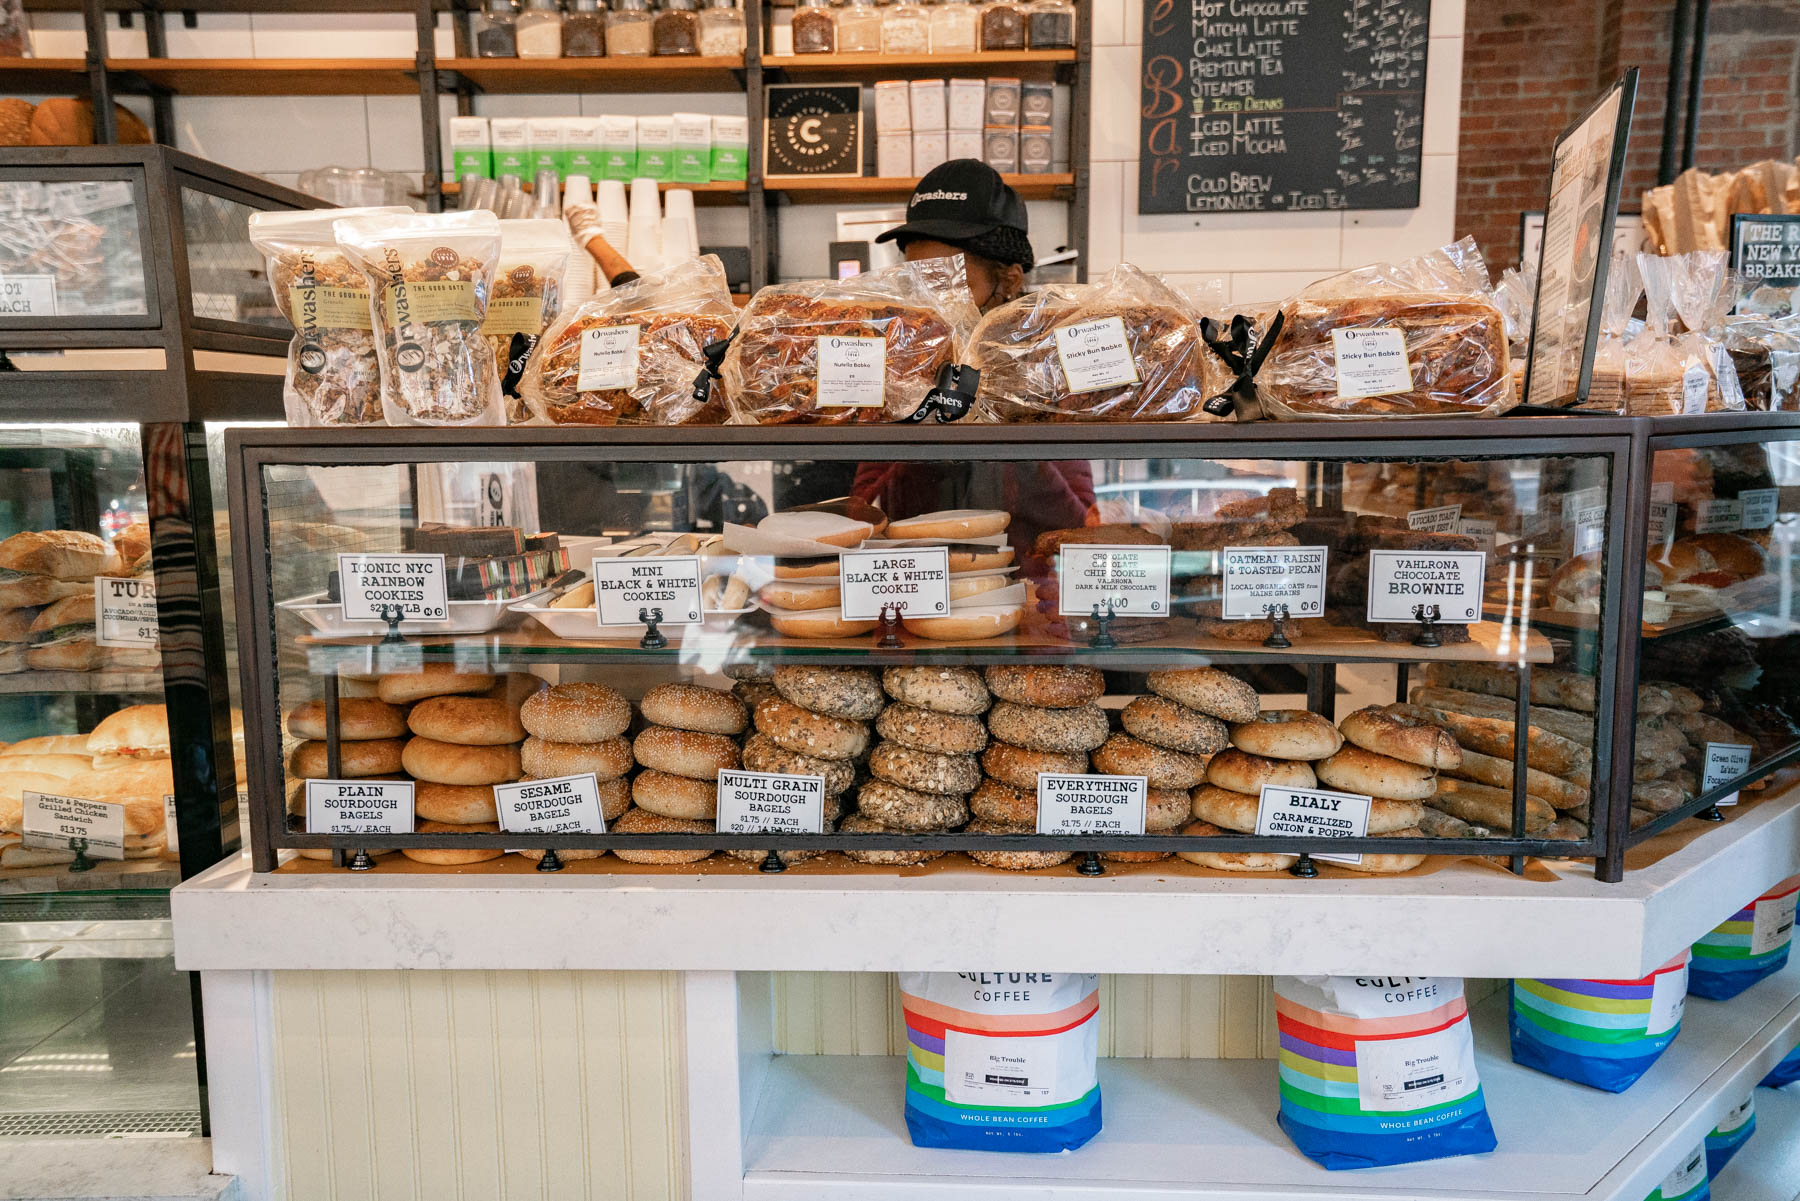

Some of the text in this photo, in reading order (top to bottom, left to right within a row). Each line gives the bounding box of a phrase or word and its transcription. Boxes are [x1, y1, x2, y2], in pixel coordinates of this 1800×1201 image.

[1192, 0, 1309, 17] HOT CHOCOLATE
[1192, 17, 1248, 38] MATCHA
[1254, 16, 1299, 36] LATTE
[1194, 37, 1283, 58] CHAI LATTE
[1189, 55, 1284, 78] PREMIUM TEA
[1190, 78, 1256, 97] STEAMER
[1211, 97, 1285, 112] ICED DRINKS
[1190, 112, 1284, 136] ICED LATTE
[1189, 134, 1287, 156] ICED MOCHA
[1187, 171, 1273, 194] COLD BREW
[1186, 192, 1265, 212] LEMONADE
[1287, 191, 1324, 210] ICED
[1323, 188, 1350, 209] TEA
[1750, 225, 1782, 241] THE
[1747, 245, 1800, 260] NEW Y
[323, 290, 356, 299] THE GOOD
[0, 300, 31, 312] ACH
[592, 329, 629, 339] Orwashers
[1068, 323, 1110, 339] Orwashers
[1345, 331, 1389, 340] Orwashers
[831, 338, 873, 348] Orwashers
[1066, 350, 1086, 360] Sticky
[1101, 343, 1123, 352] Babka
[873, 559, 916, 570] LARGE
[1229, 554, 1321, 564] OATMEAL RAISIN
[1396, 560, 1460, 570] VAHLRONA
[351, 563, 433, 574] ICONIC NYC
[632, 567, 664, 577] MINI
[1110, 570, 1146, 578] COOKIE
[1228, 565, 1321, 575] & TOASTED PECAN
[361, 576, 425, 587] RAINBOW
[846, 570, 944, 583] BLACK & WHITE
[1394, 571, 1460, 580] CHOCOLATE
[601, 578, 697, 590] BLACK & WHITE
[872, 584, 918, 595] COOKIE
[1388, 583, 1464, 595] BROWNIE
[365, 590, 424, 600] COOKIES
[623, 591, 676, 601] COOKIES
[723, 776, 819, 792] MULTI GRAIN
[1047, 780, 1137, 792] EVERYTHING
[338, 786, 384, 797] PLAIN
[520, 782, 572, 799] SESAME
[40, 795, 63, 804] Pesto
[74, 799, 107, 811] Peppers
[514, 794, 583, 812] SOURDOUGH
[735, 791, 806, 804] SOURDOUGH
[1056, 794, 1128, 804] SOURDOUGH
[1289, 795, 1341, 811] BIALY
[324, 799, 398, 809] SOURDOUGH
[749, 803, 791, 814] BAGELS
[38, 802, 108, 819] Grilled Chicken
[340, 811, 383, 820] BAGELS
[530, 808, 571, 821] BAGELS
[1071, 806, 1113, 815] BAGELS
[54, 812, 93, 824] Sandwich
[773, 818, 799, 826] EACH
[1273, 812, 1353, 829] CARAMELIZED
[367, 825, 391, 833] EACH
[556, 821, 581, 832] EACH
[1095, 821, 1121, 829] EACH
[1269, 822, 1353, 837] ONION & POPPY
[974, 990, 1030, 1002] COFFEE
[1385, 984, 1437, 1003] COFFEE
[1001, 1056, 1027, 1064] Trouble
[1416, 1055, 1440, 1065] Trouble
[960, 1114, 990, 1122] WHOLE
[1380, 1109, 1463, 1129] WHOLE BEAN COFFEE
